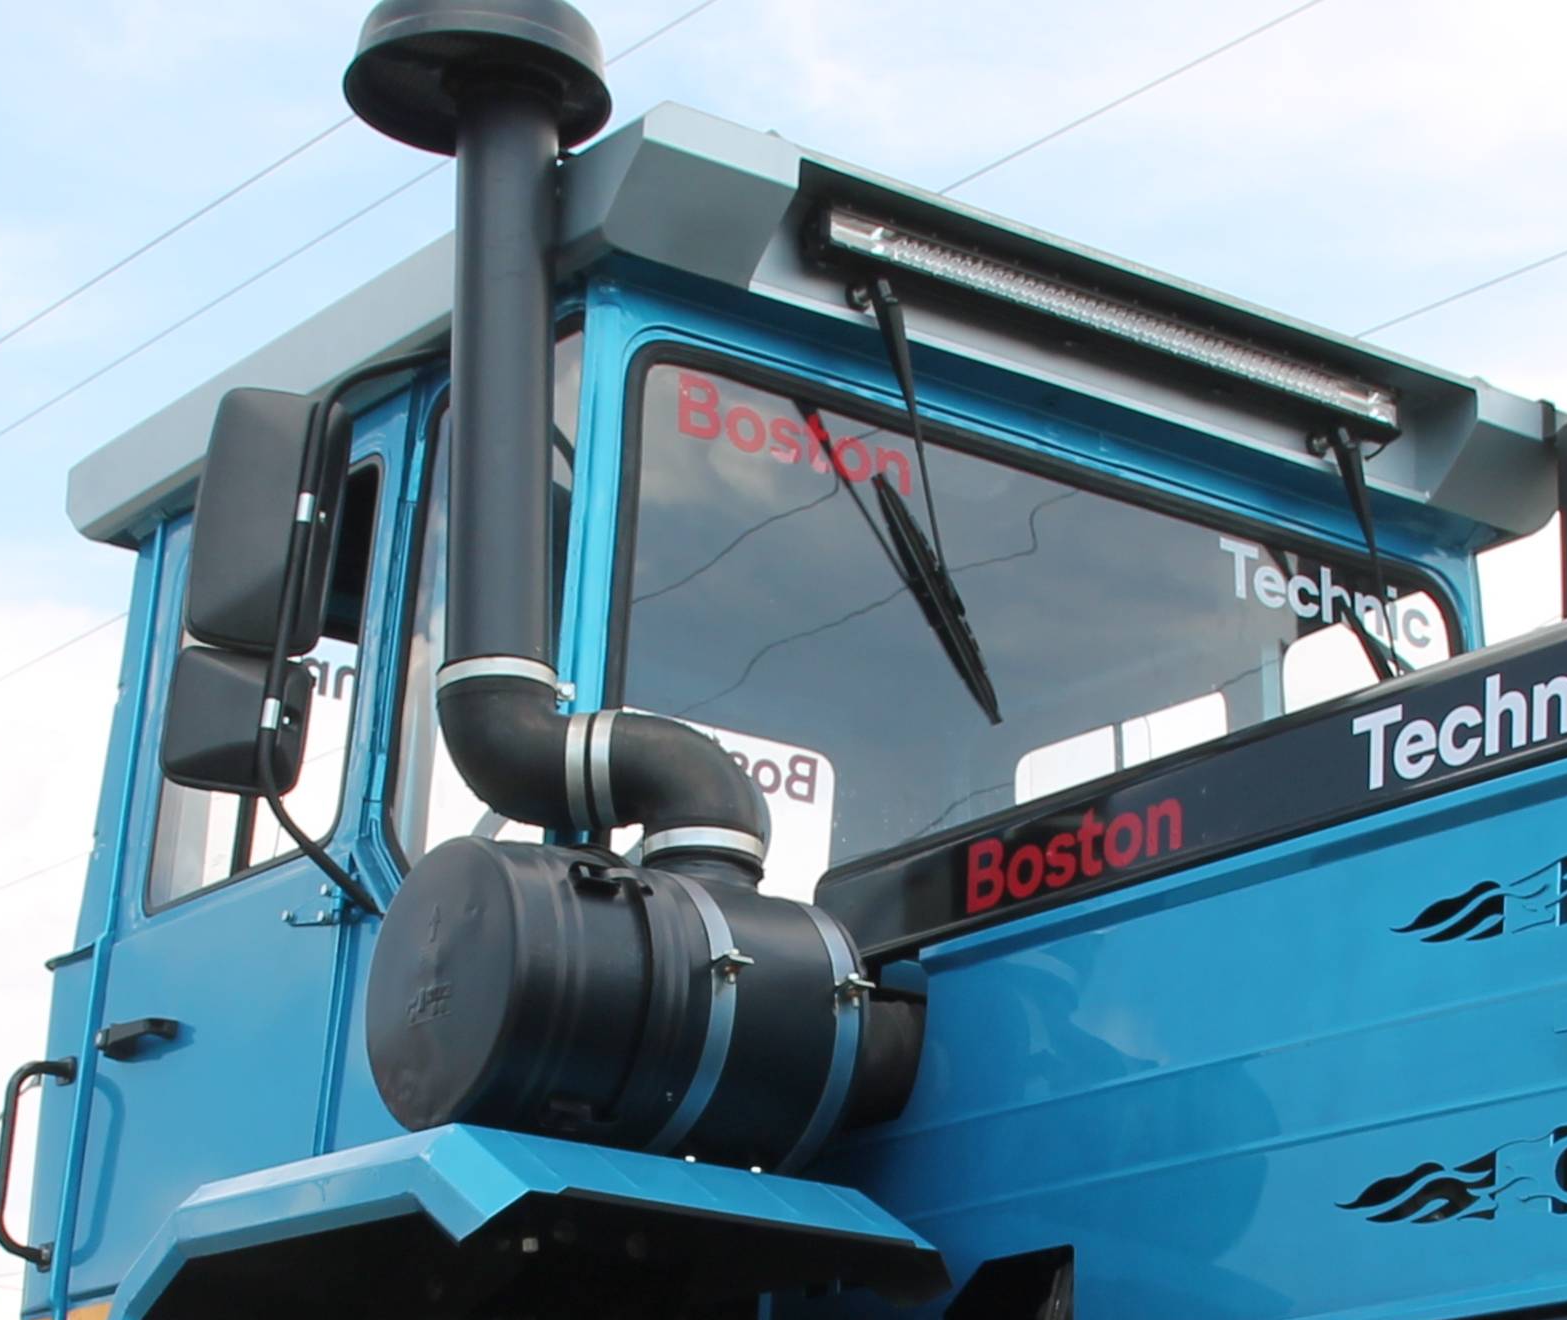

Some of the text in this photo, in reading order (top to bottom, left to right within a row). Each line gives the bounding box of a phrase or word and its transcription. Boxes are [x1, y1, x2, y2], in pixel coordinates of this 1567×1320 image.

[678, 372, 913, 497] Boston
[1220, 536, 1431, 648] Technic
[965, 798, 1183, 914] Boston
